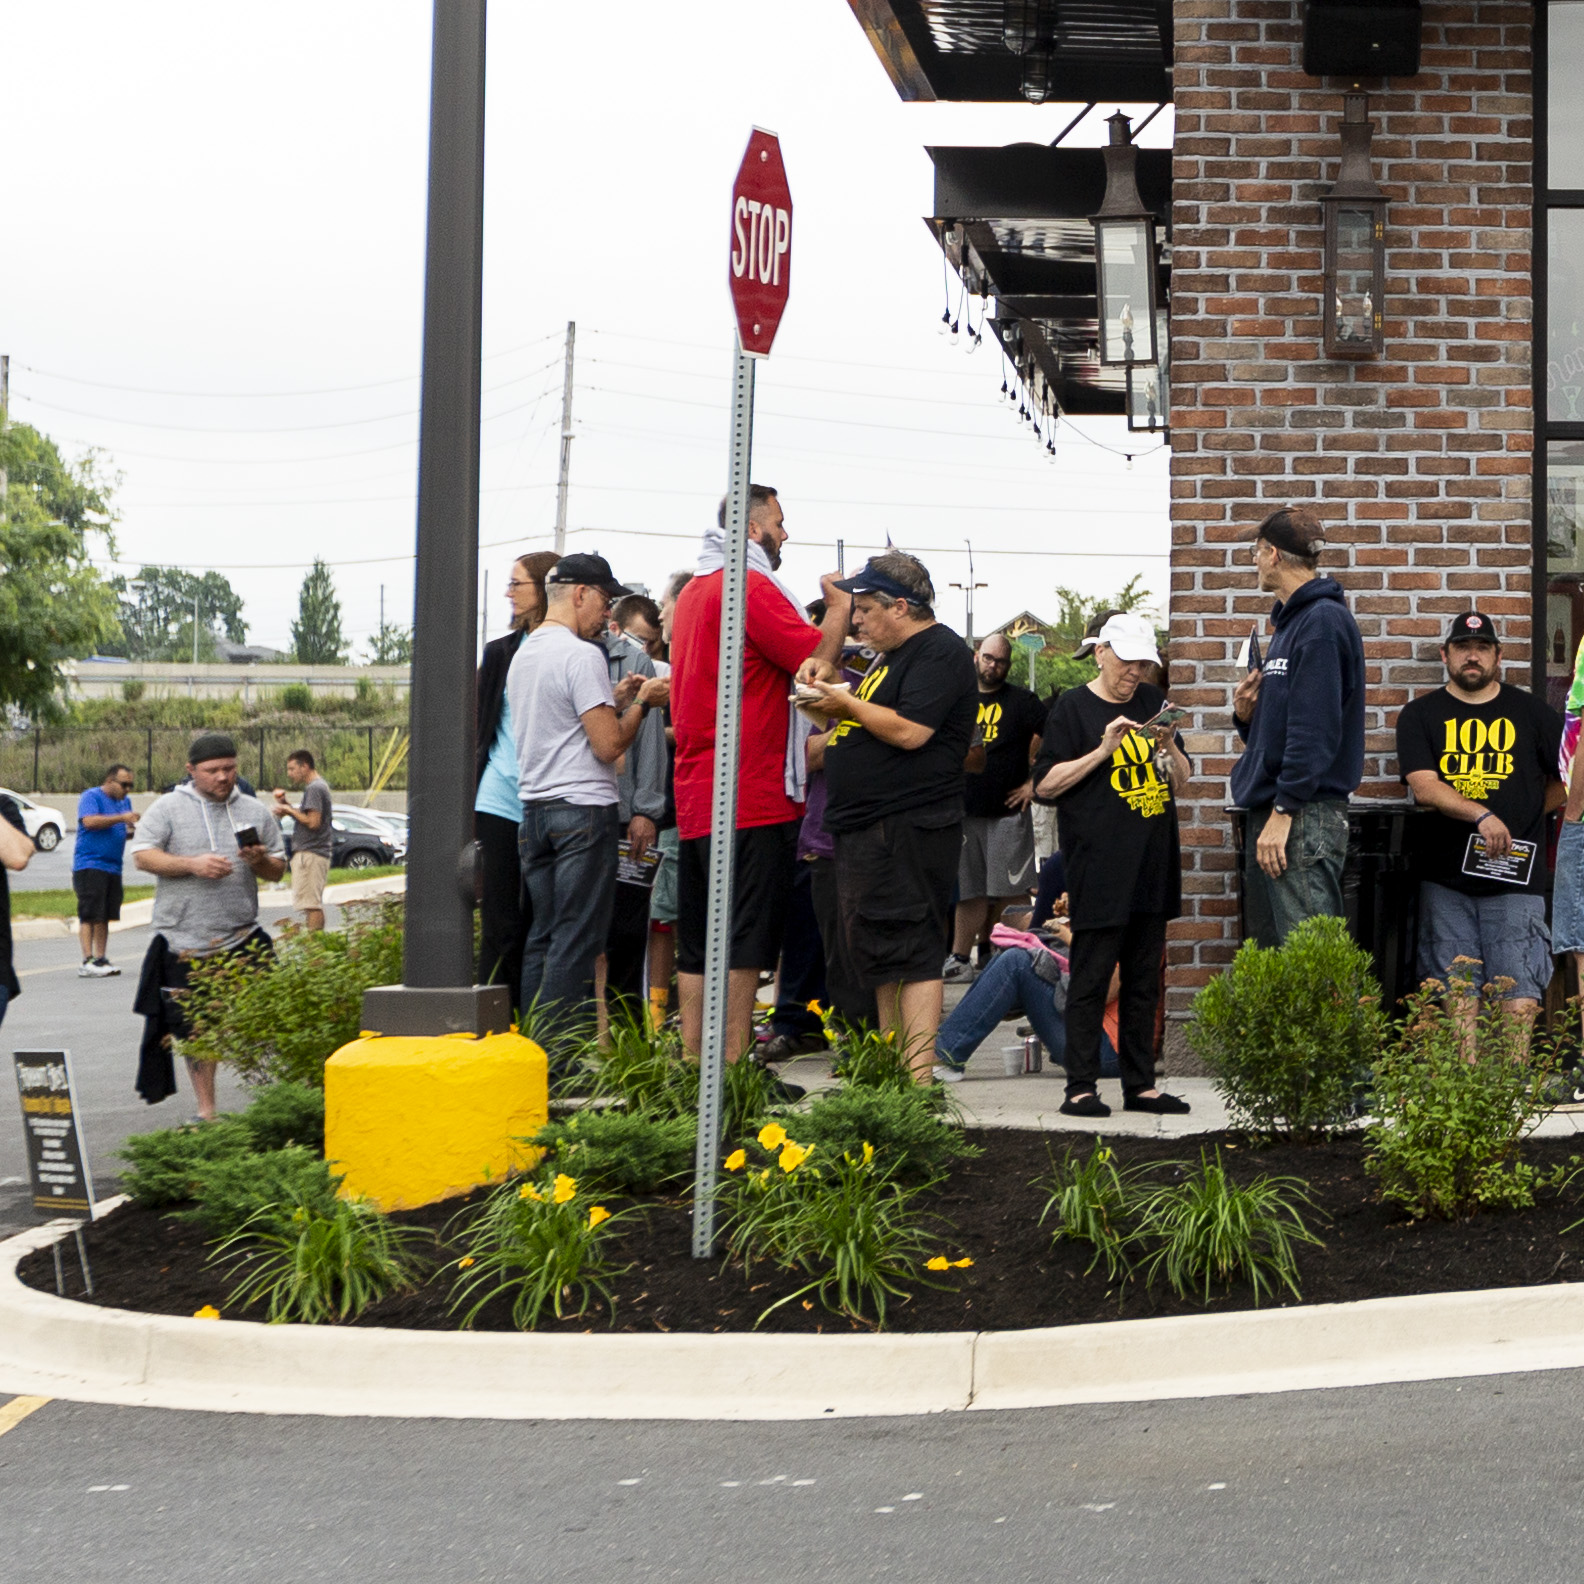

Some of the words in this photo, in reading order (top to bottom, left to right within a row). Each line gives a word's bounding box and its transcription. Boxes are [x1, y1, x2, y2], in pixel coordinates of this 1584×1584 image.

[732, 196, 789, 286] STOP
[1442, 717, 1516, 754] 100
[1439, 752, 1514, 775] CLUB
